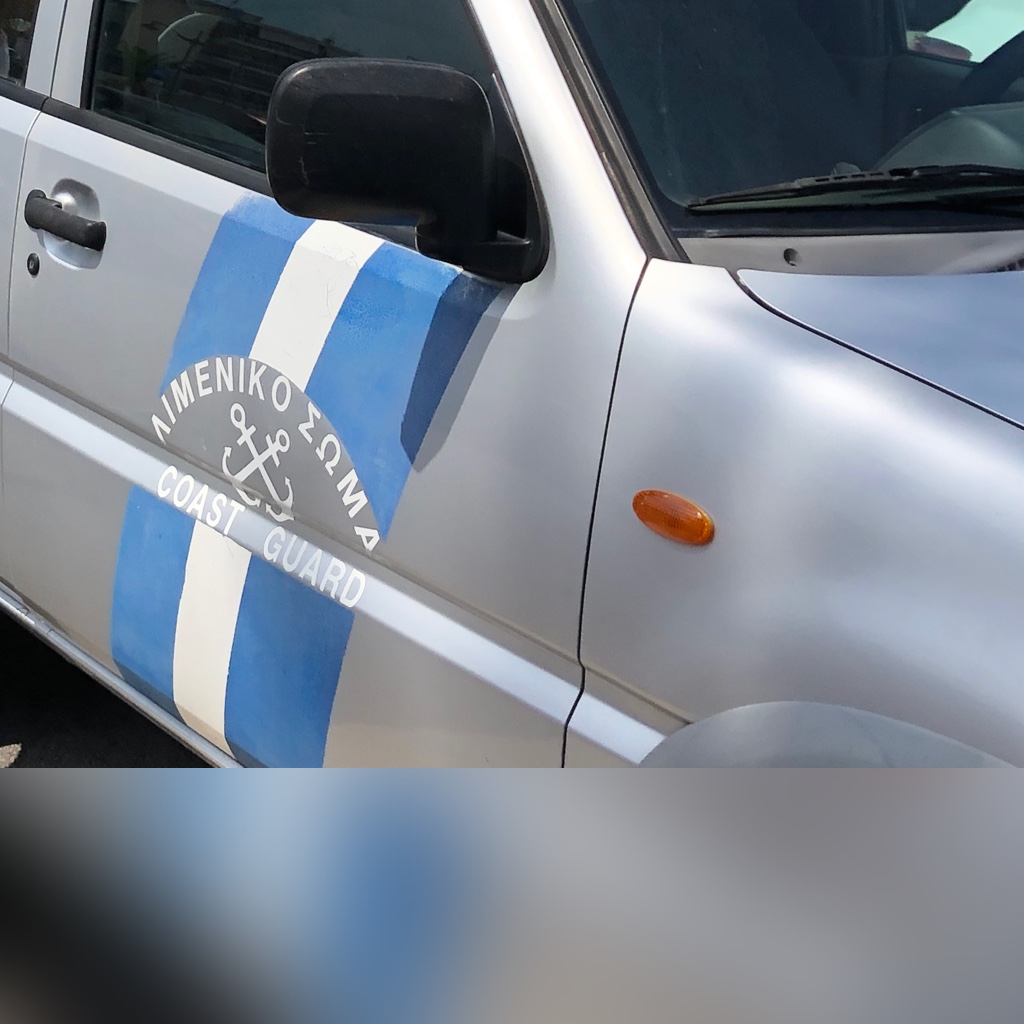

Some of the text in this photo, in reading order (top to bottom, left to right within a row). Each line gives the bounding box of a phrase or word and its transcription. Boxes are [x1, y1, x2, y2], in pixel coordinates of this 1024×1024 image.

[150, 357, 381, 553] ΛΙΜΕΝΙΚΟ ΣΩΜΑ
[157, 465, 367, 609] COAST GUARD
